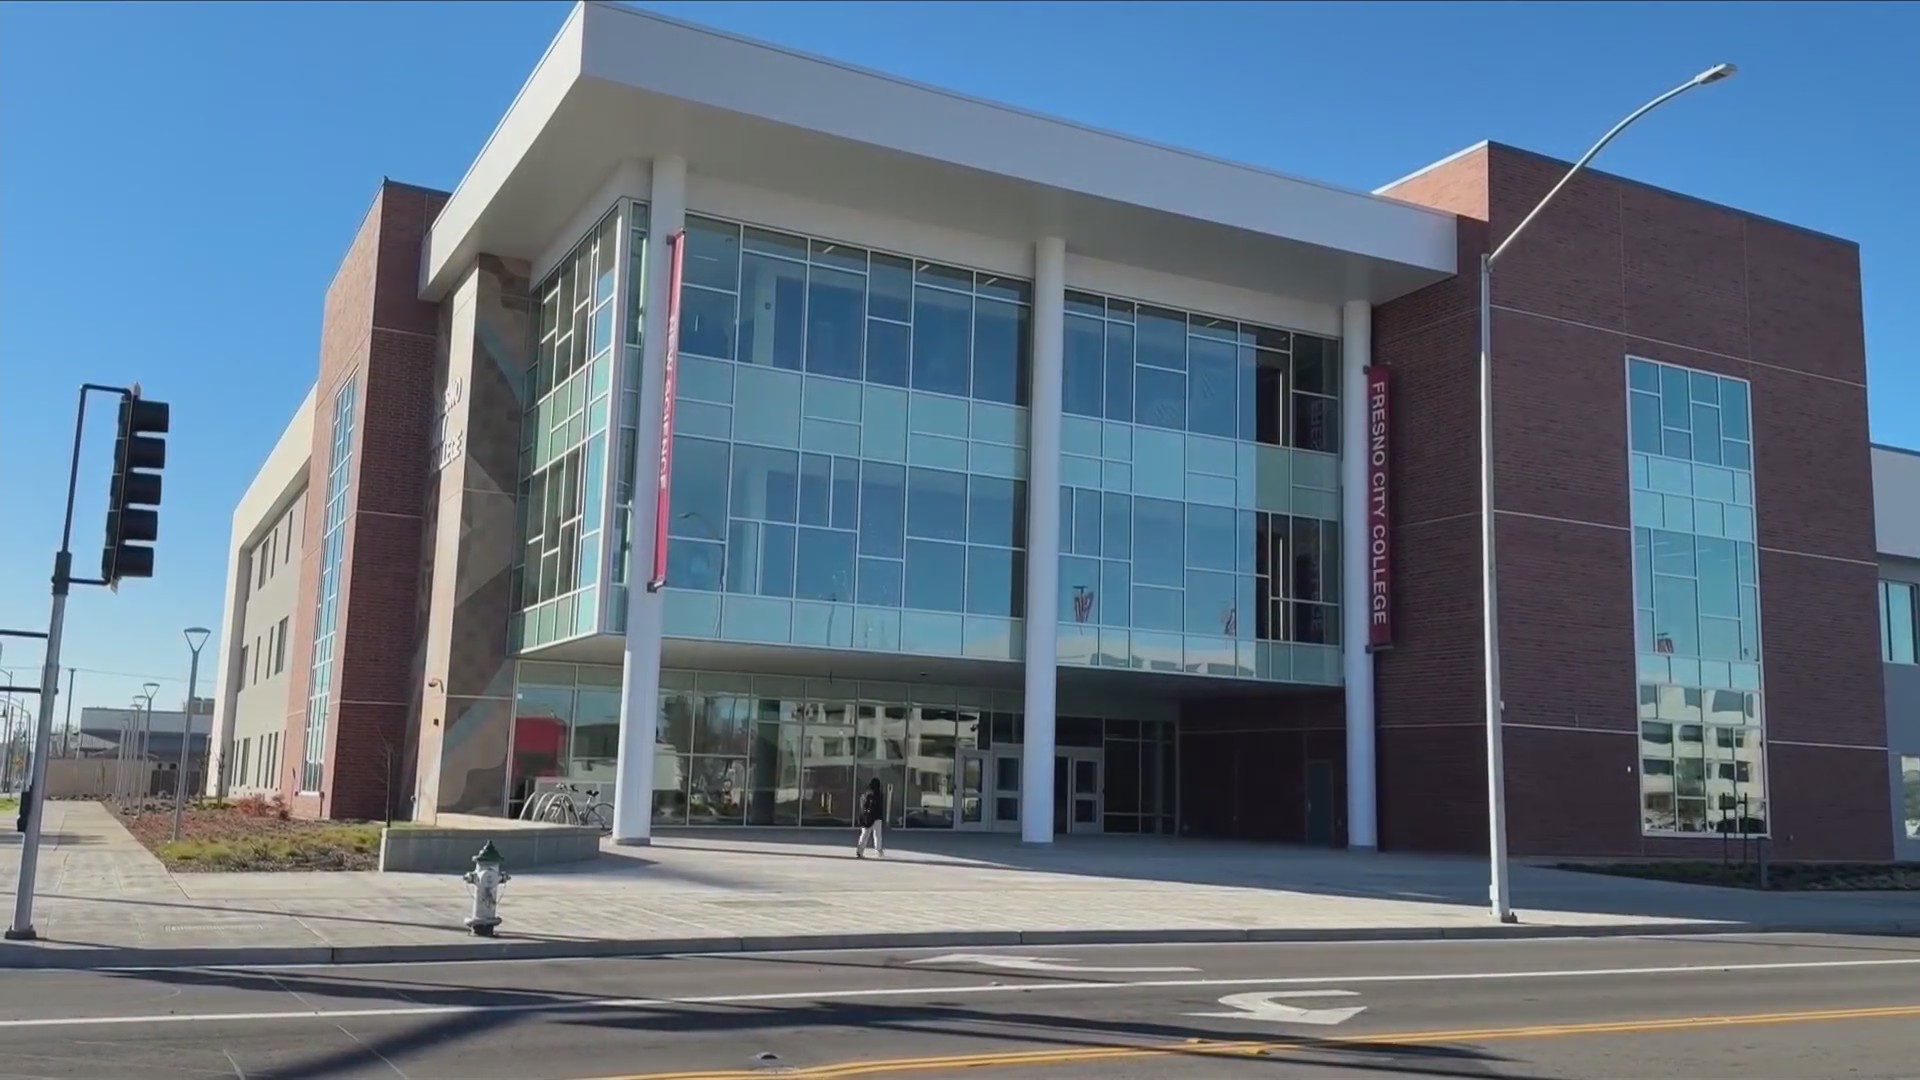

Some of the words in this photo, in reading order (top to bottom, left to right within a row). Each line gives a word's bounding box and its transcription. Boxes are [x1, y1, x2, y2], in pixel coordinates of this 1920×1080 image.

[660, 379, 672, 489] SCIENCE
[1372, 381, 1386, 466] FRESNO
[1372, 472, 1386, 518] CITY
[1372, 524, 1387, 625] COLLEGE
